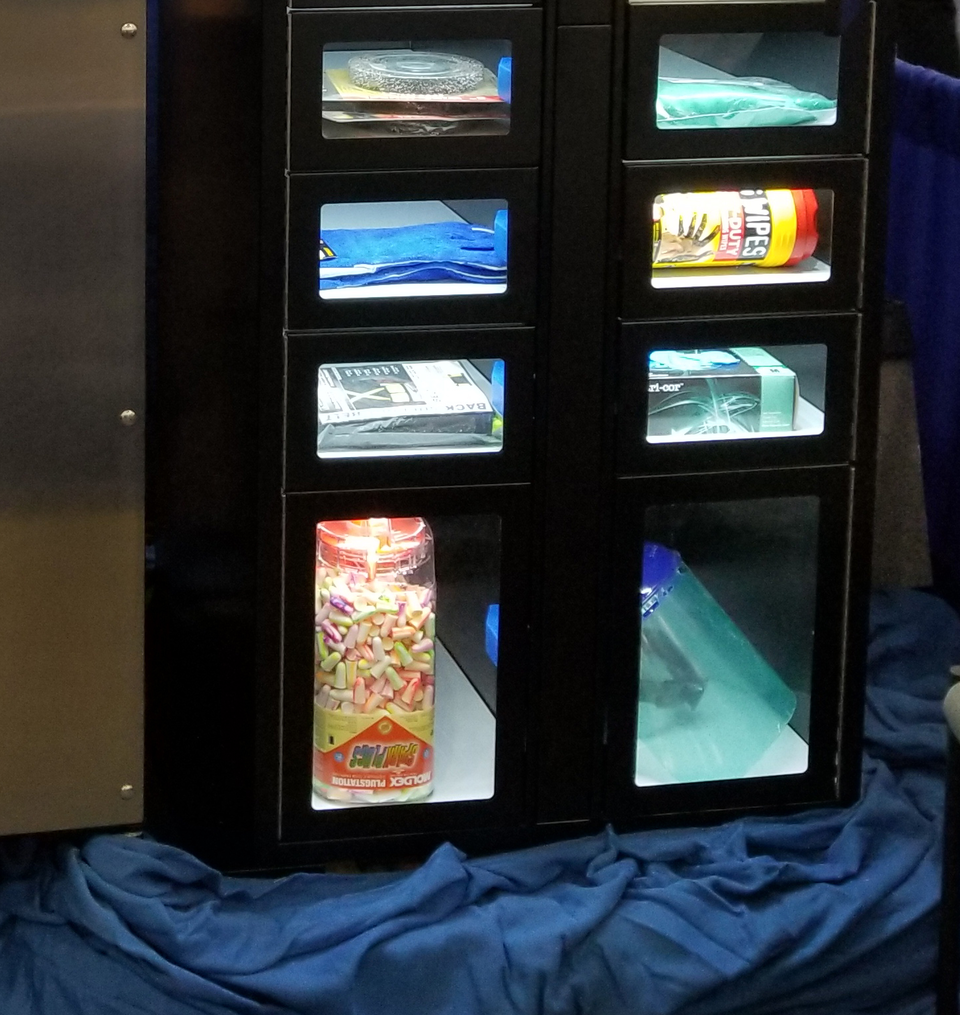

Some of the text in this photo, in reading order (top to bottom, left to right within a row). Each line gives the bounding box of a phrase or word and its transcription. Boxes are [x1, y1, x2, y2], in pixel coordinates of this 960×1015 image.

[742, 198, 771, 258] WIPES
[446, 402, 487, 411] BACK
[332, 771, 432, 788] MOLDEX PLUGSTATION
